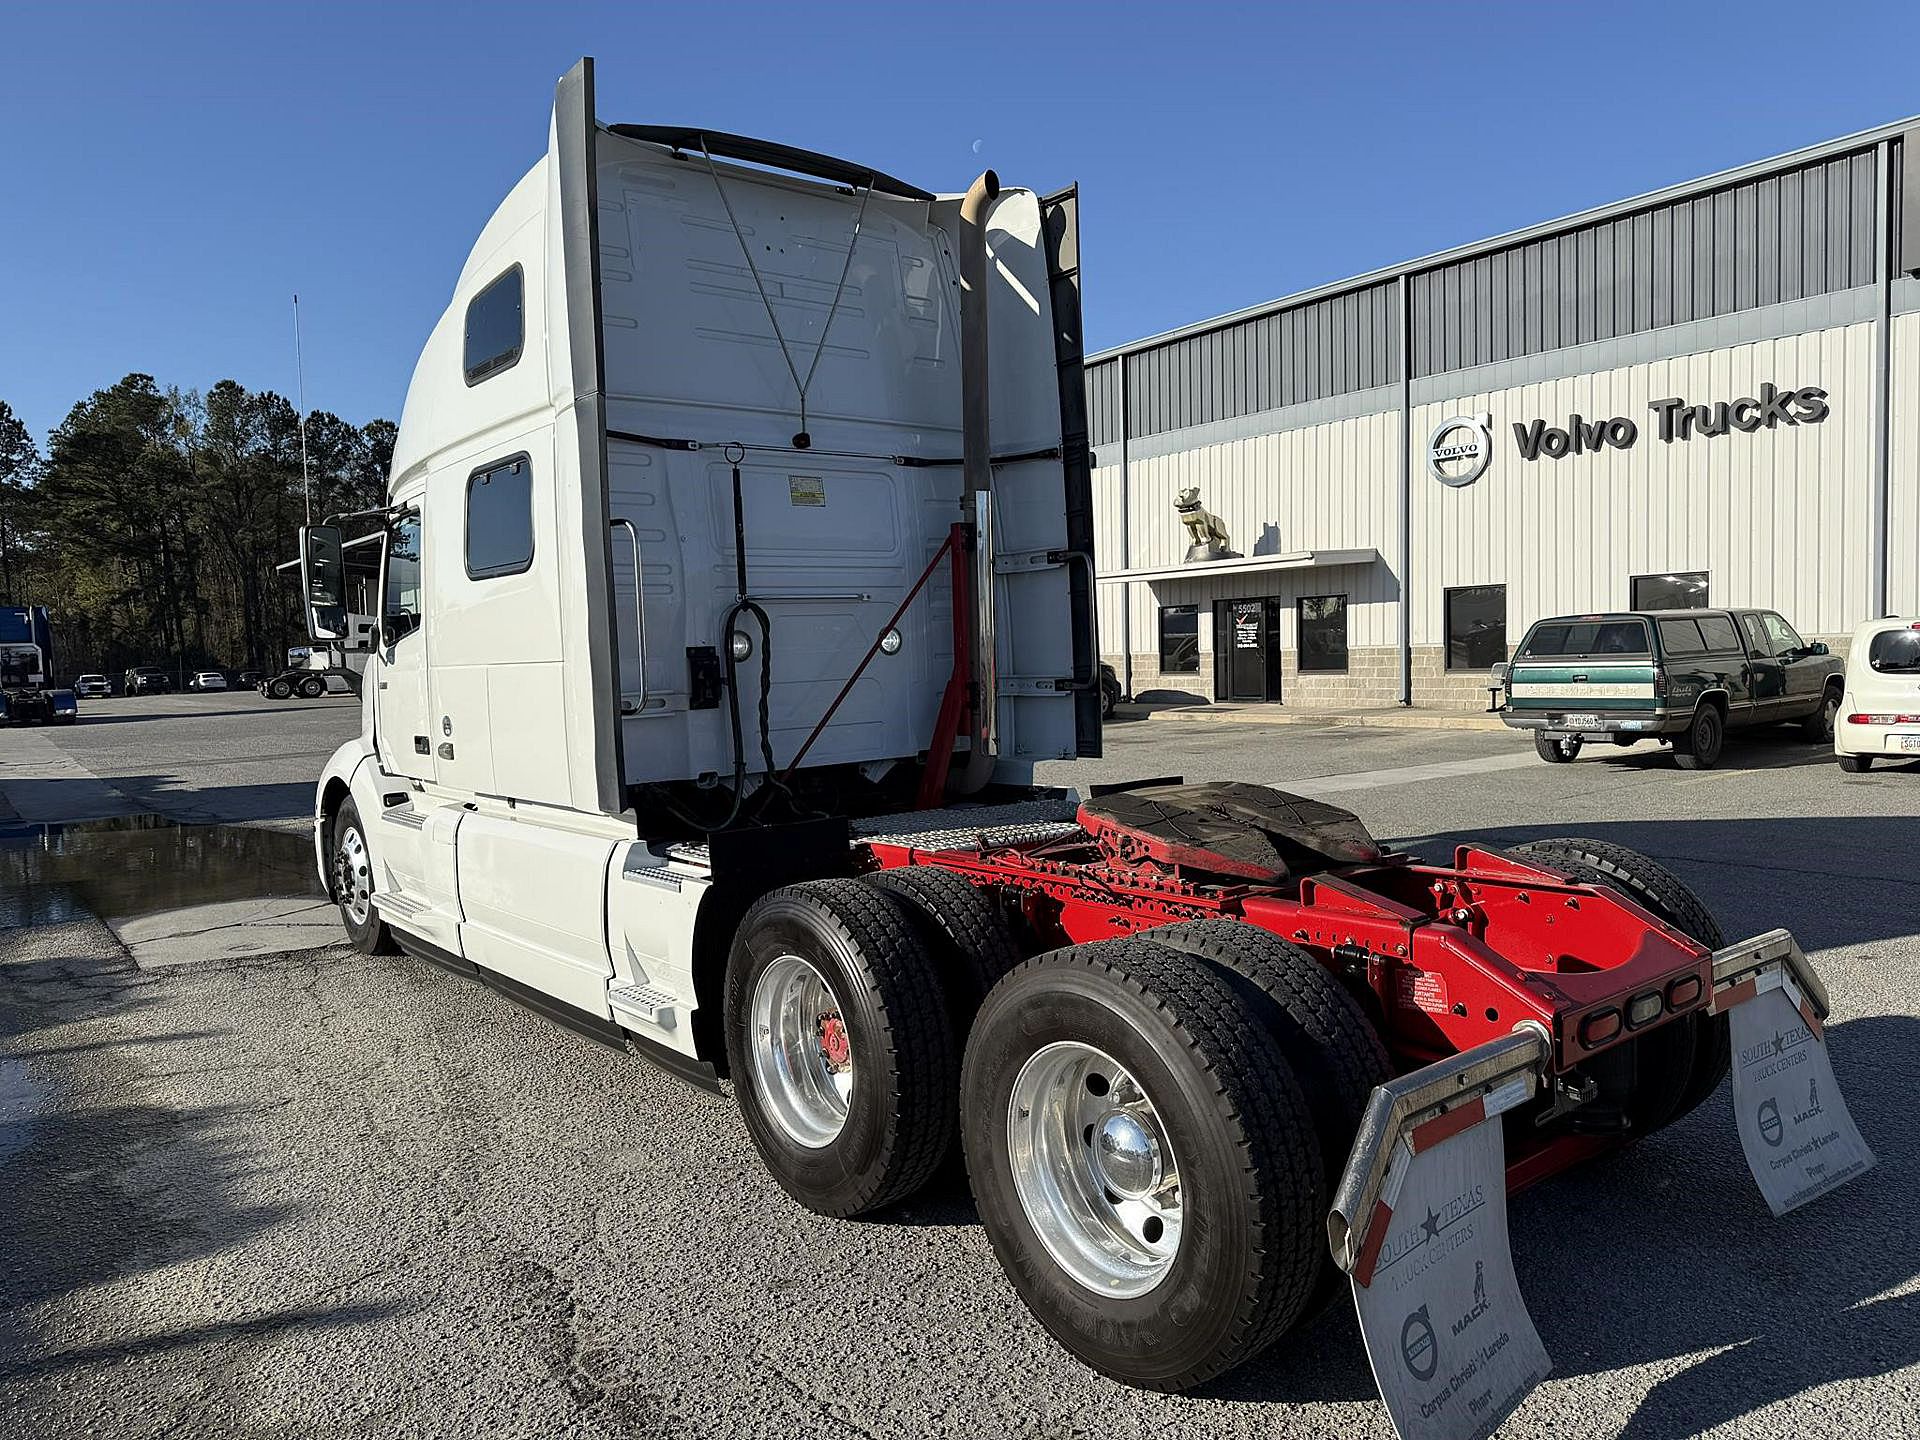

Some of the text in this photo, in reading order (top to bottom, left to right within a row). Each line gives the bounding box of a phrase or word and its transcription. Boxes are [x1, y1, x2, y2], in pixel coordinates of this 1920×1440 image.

[1512, 382, 1830, 461] Volvo Trucks
[1433, 443, 1478, 458] VOLVO
[1238, 604, 1255, 613] 5502
[1742, 1041, 1771, 1063] SOUTH
[1777, 1049, 1807, 1072] CENTERS
[1793, 1107, 1822, 1125] MACK
[1441, 1185, 1483, 1221] TEXAS
[1451, 1300, 1488, 1336] MACK
[1420, 1387, 1451, 1418] Corpus
[1451, 1358, 1477, 1392] Christi
[1483, 1332, 1510, 1360] Laredo
